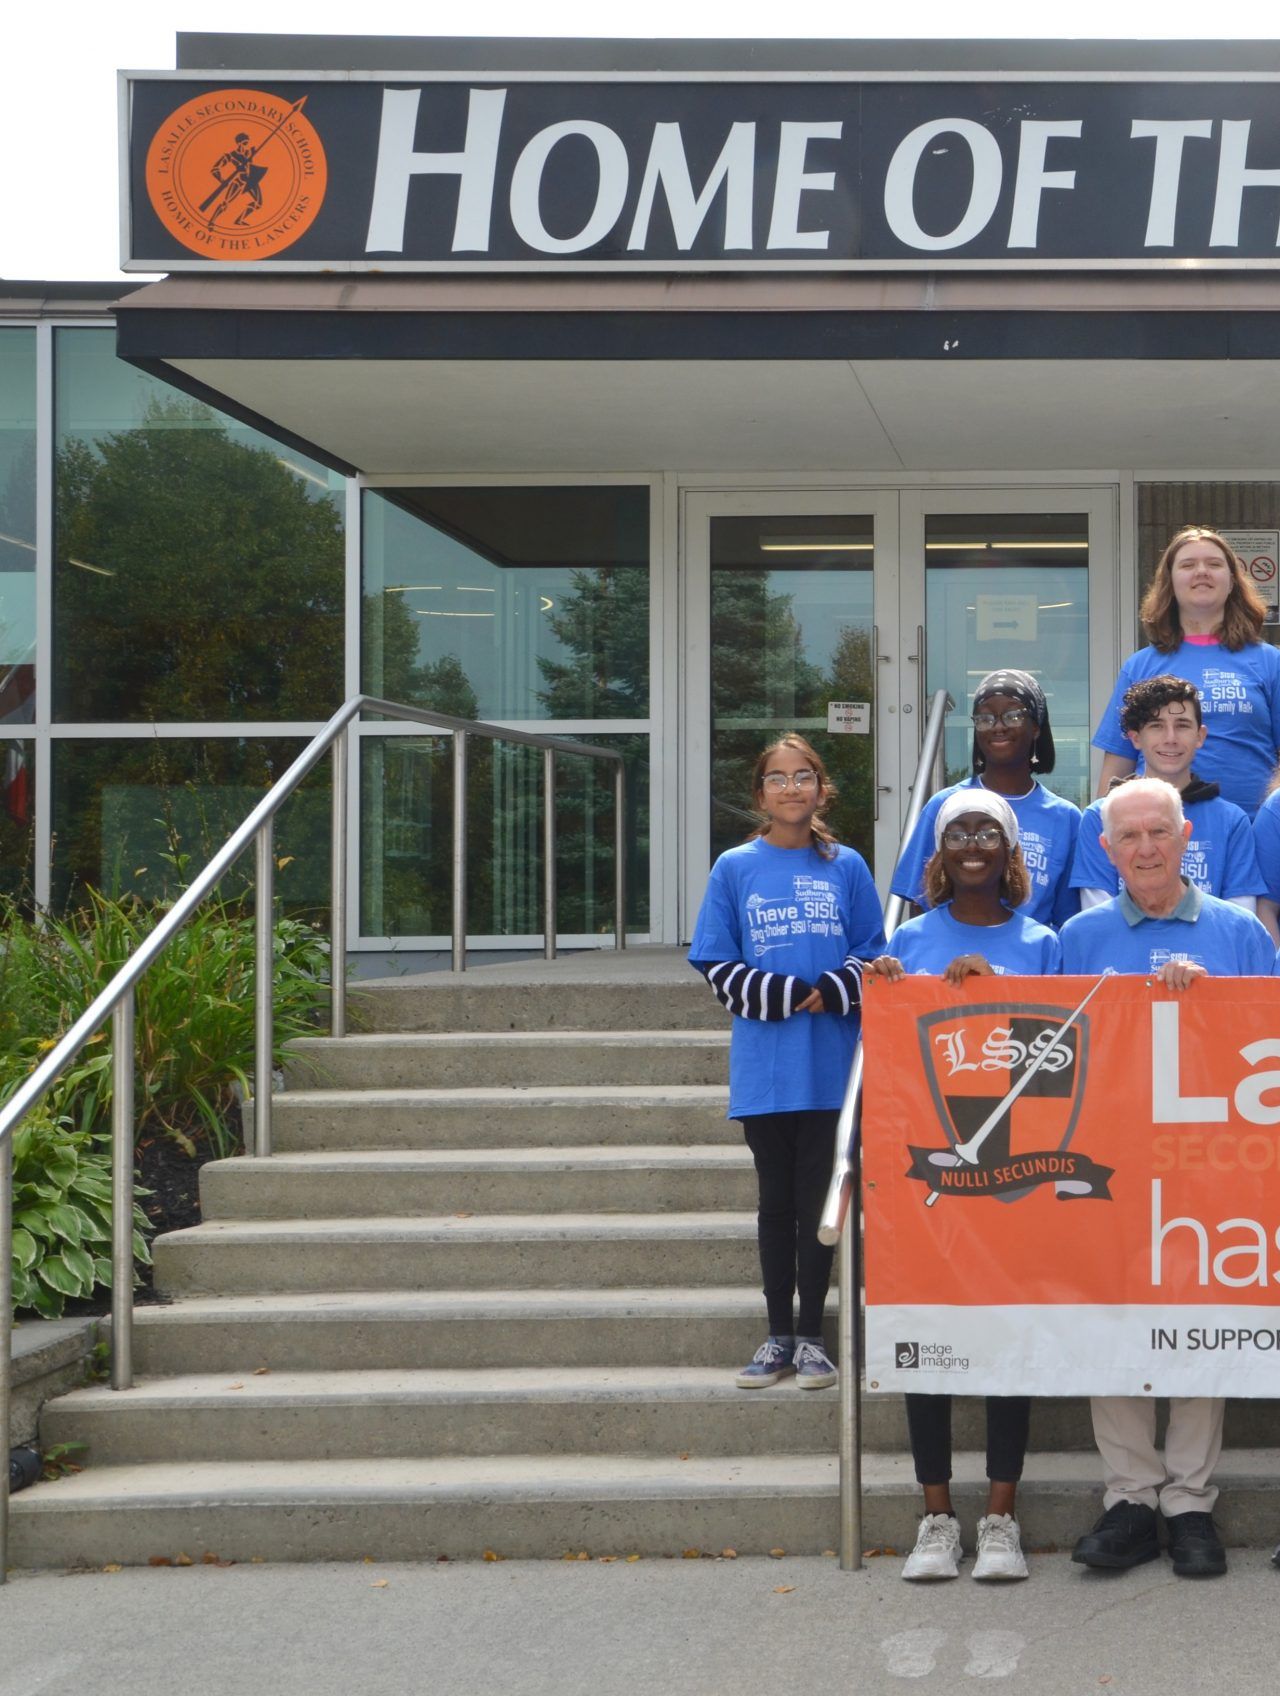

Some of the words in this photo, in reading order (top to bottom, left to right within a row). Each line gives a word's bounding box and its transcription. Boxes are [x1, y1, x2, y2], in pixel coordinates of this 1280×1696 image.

[158, 115, 197, 175] LASALLE
[195, 99, 287, 124] SECONDARY
[286, 122, 315, 178] SCHOOL
[364, 87, 845, 254] HOME
[883, 117, 1083, 251] OF
[161, 190, 195, 233] HOME
[195, 229, 215, 245] OF
[219, 237, 251, 251] THE
[253, 195, 310, 248] LANCERS
[1211, 686, 1247, 700] SISU
[1201, 701, 1212, 713] ISU
[1213, 700, 1236, 716] Family
[1023, 850, 1048, 871] ISU
[812, 880, 829, 891] SISU
[747, 911, 753, 927] I
[756, 904, 798, 925] have
[804, 901, 840, 920] SISU
[791, 920, 806, 934] SISU
[807, 920, 829, 937] Family
[935, 1025, 1074, 1077] LSS
[940, 1167, 989, 1188] NULLI
[993, 1157, 1076, 1185] SECUNDIS
[920, 1343, 953, 1357] edge
[1150, 1328, 1178, 1352] IN
[920, 1355, 970, 1370] imaging
